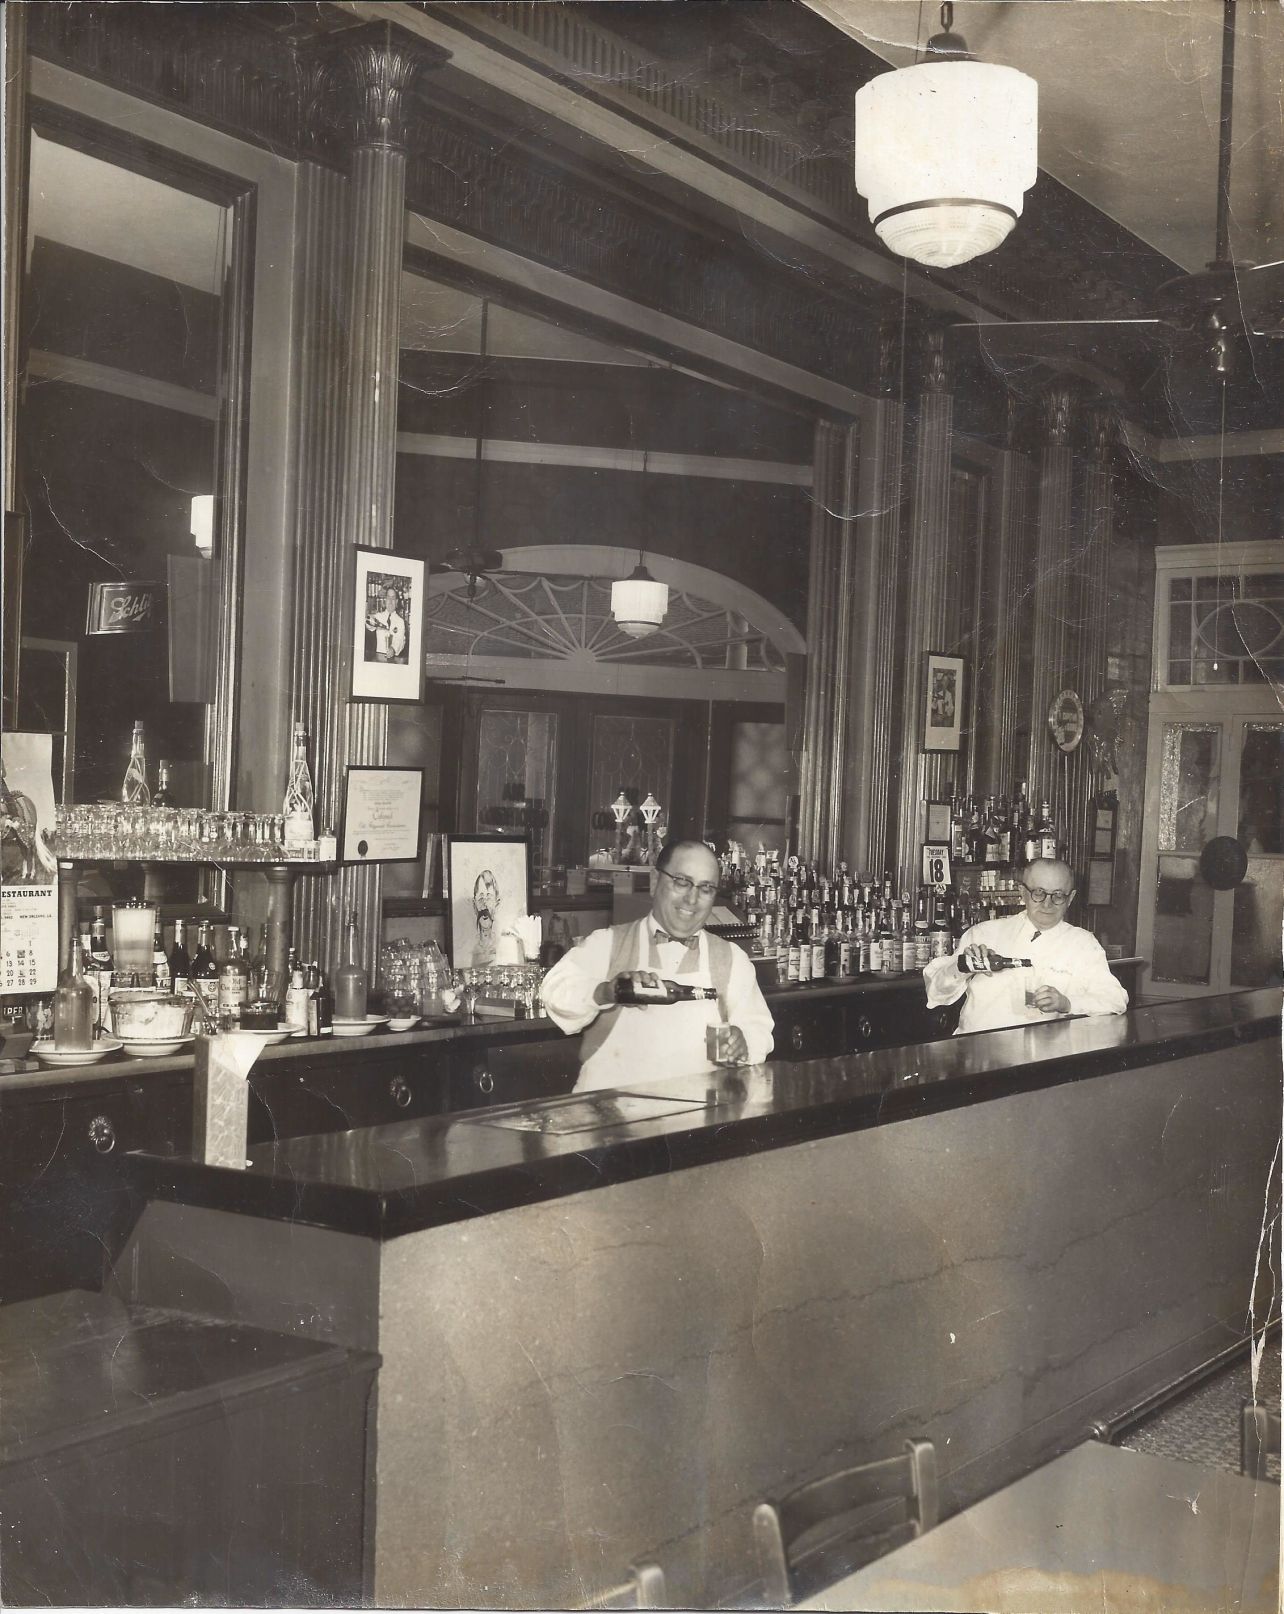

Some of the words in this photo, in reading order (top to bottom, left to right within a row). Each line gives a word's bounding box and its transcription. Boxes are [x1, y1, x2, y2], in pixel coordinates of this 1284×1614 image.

[930, 858, 944, 883] 18
[6, 969, 14, 977] 20
[6, 979, 14, 987] 27
